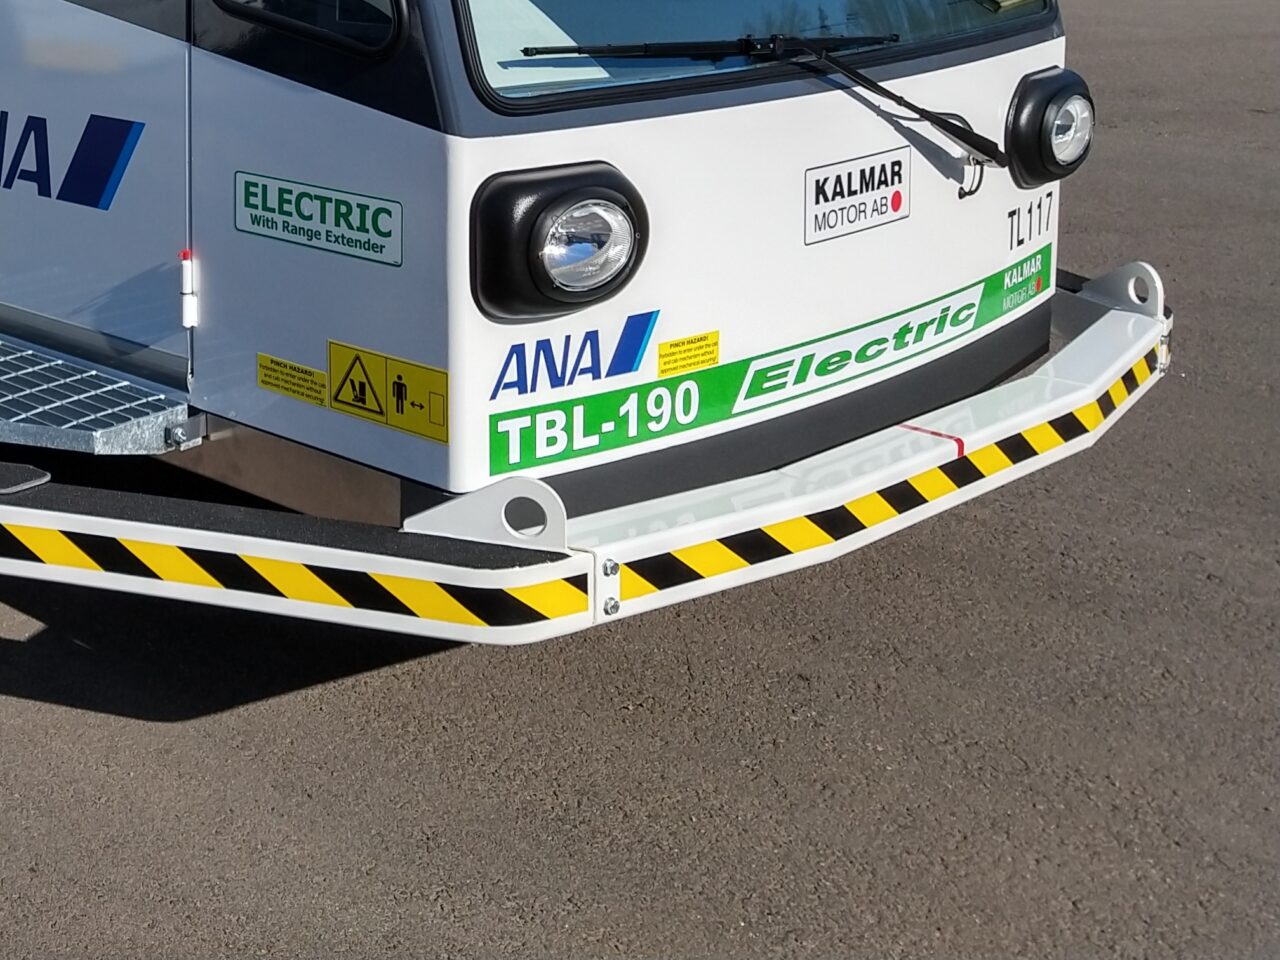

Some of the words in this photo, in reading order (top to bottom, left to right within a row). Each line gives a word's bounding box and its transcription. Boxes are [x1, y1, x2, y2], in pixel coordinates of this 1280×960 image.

[814, 160, 903, 205] KALMAR
[243, 180, 393, 238] ELECTRIC
[814, 201, 868, 233] MOTOR
[871, 196, 888, 222] AB
[1008, 191, 1053, 251] TL117
[250, 212, 279, 231] With
[282, 221, 322, 242] Range
[325, 230, 386, 255] Extender
[1003, 254, 1042, 290] KALMAR
[1002, 287, 1028, 312] MOTOR
[1027, 281, 1037, 299] AB
[269, 358, 288, 369] PINCH
[489, 329, 602, 401] ANA
[669, 341, 686, 350] PINCH
[743, 301, 977, 401] Electric
[497, 380, 700, 465] TBL-190
